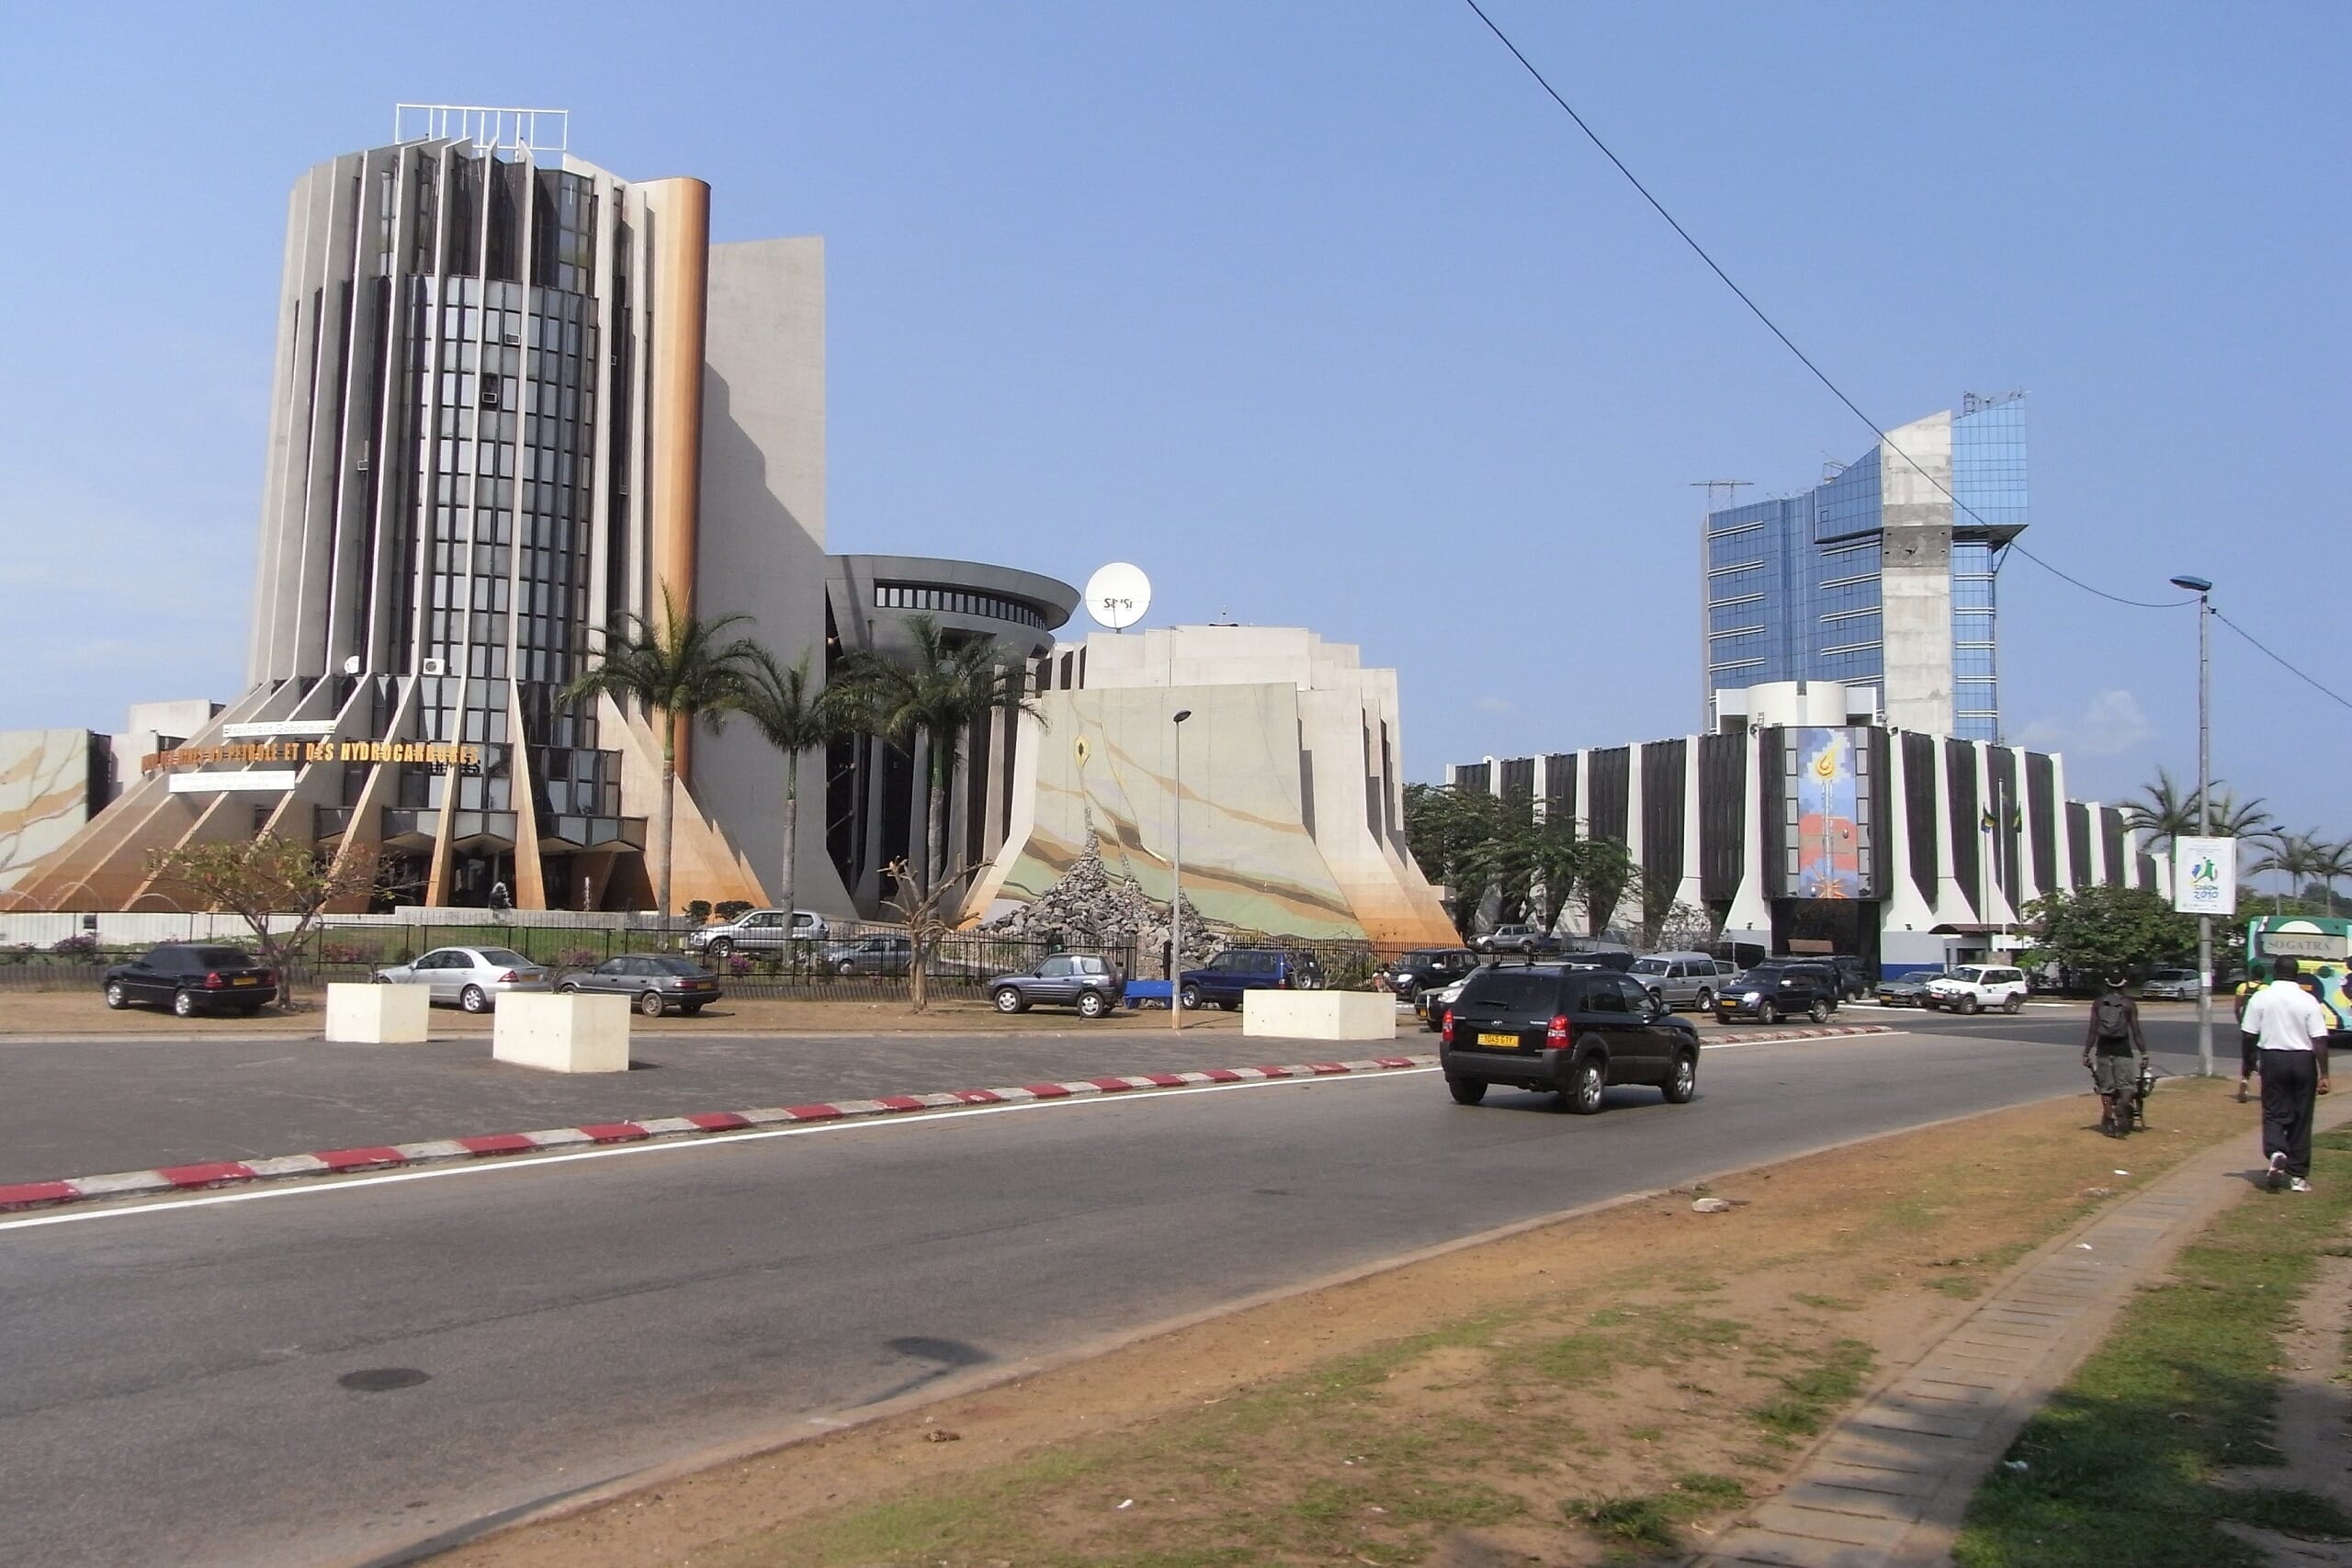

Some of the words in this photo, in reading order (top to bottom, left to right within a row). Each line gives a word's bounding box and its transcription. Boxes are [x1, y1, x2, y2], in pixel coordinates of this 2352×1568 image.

[284, 742, 300, 761] ET
[305, 742, 334, 761] DES
[340, 741, 479, 764] HYDROCARBURES
[2193, 891, 2219, 899] 2010
[2267, 940, 2331, 951] SOGATRA
